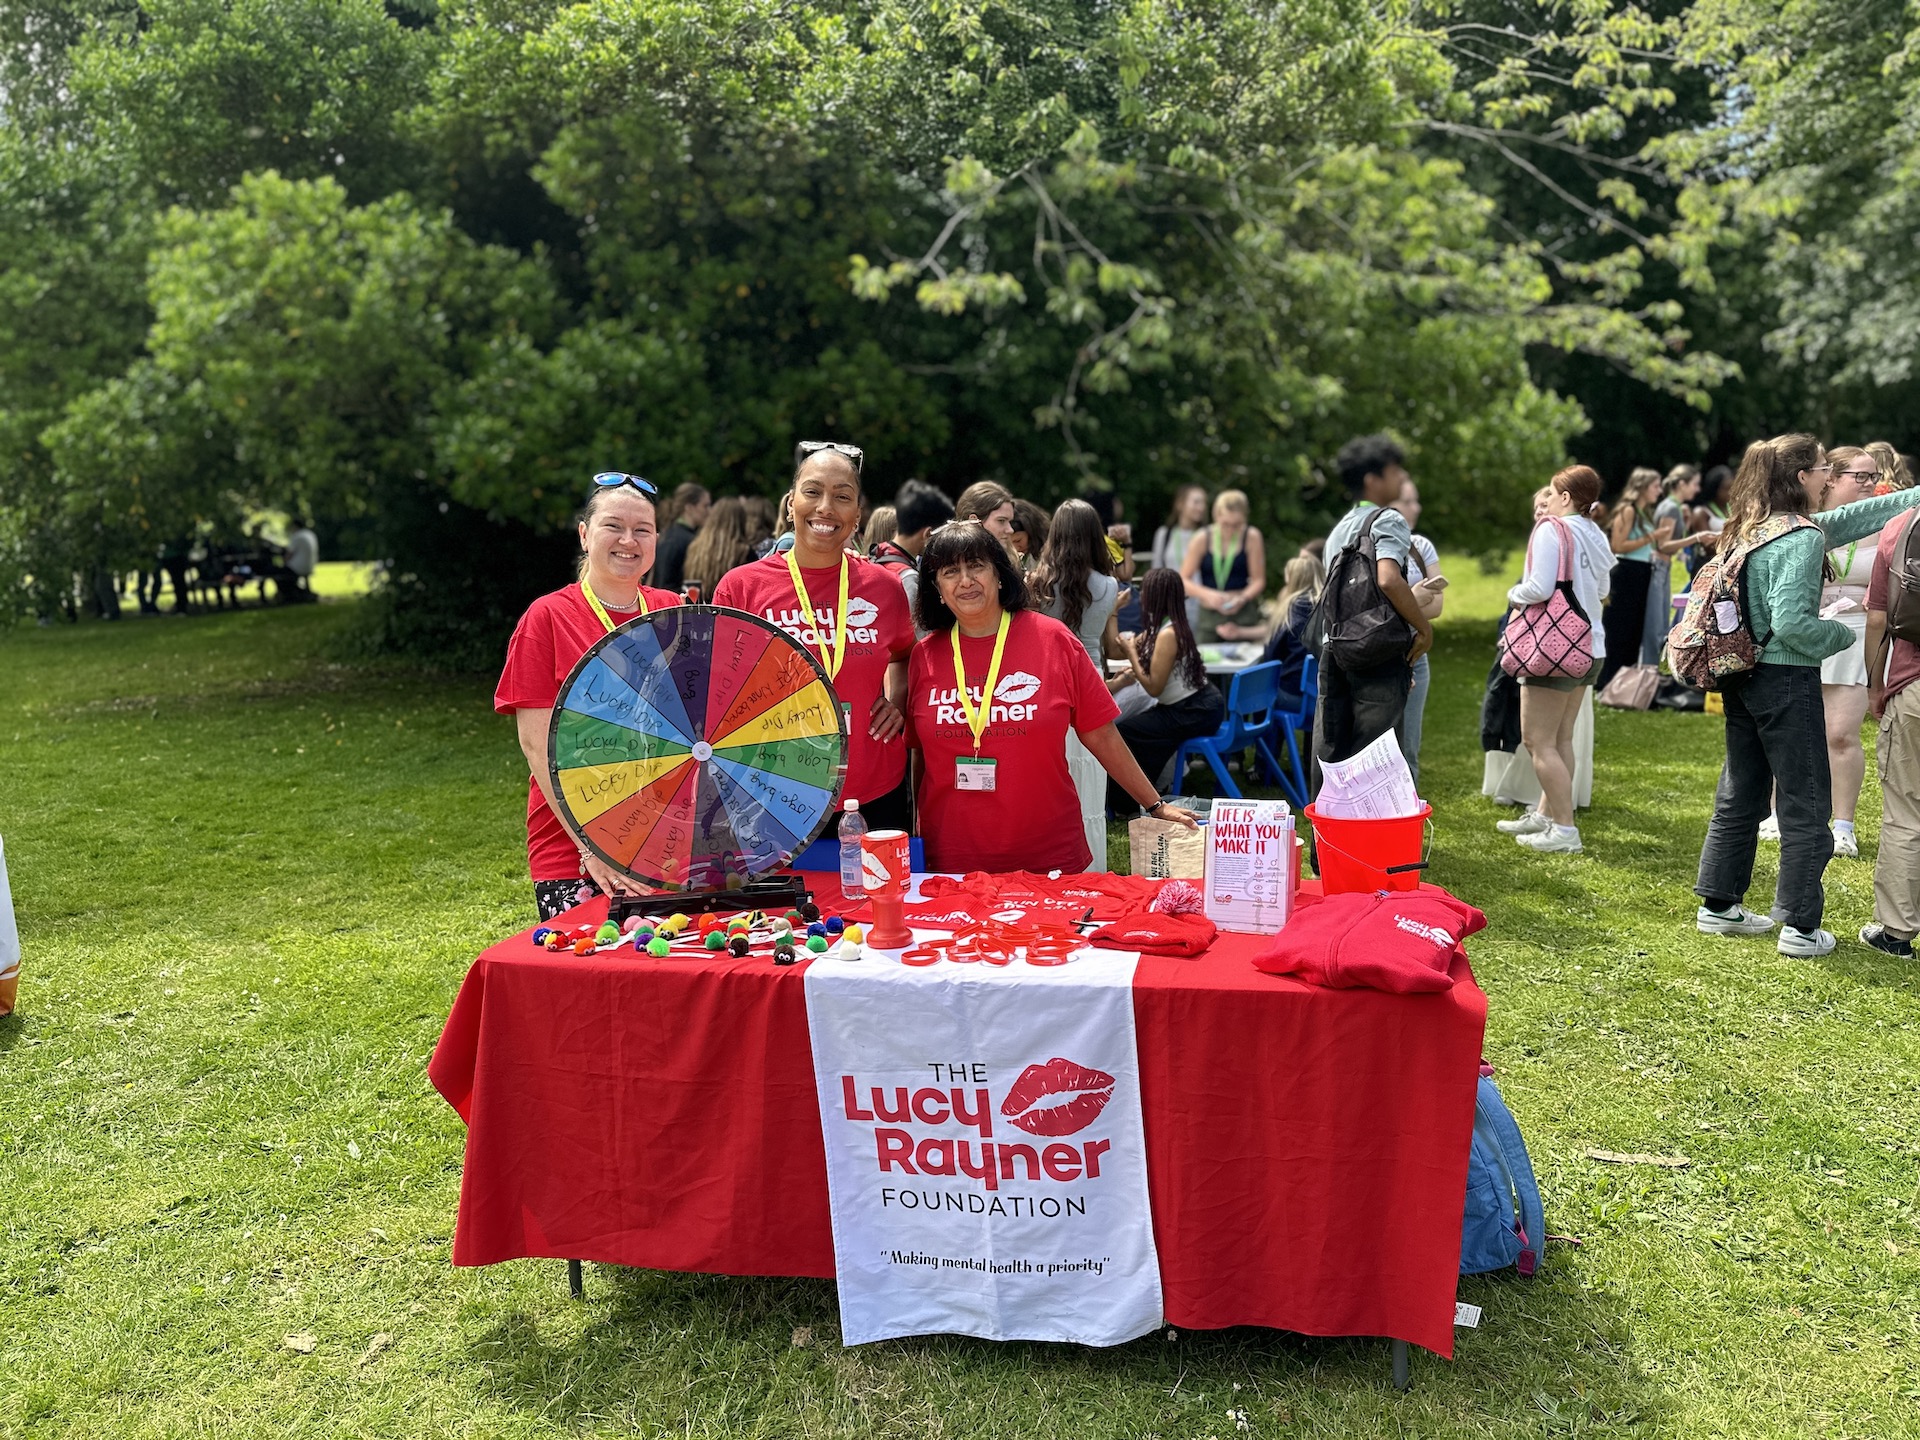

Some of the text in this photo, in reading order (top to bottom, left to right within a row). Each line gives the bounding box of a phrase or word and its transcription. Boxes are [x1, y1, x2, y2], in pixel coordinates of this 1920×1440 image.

[583, 673, 634, 719] Lucky
[787, 703, 825, 727] Lucky
[936, 703, 1038, 727] Raner
[574, 732, 619, 756] Lucky
[935, 726, 1027, 739] FOUNATION
[579, 772, 627, 803] Lucky
[599, 807, 650, 846] Lucky
[1216, 808, 1256, 823] LIFE IS
[1215, 823, 1281, 839] WHAT YOU
[643, 824, 686, 873] Lucky
[1150, 851, 1158, 866] ARE
[1215, 838, 1267, 855] MAKE IT
[1393, 914, 1430, 932] Lucy
[1396, 921, 1449, 949] Rayner
[928, 1063, 988, 1083] THE
[841, 1075, 993, 1138] Lucy
[874, 1127, 1111, 1191] Rayner
[882, 1188, 1086, 1218] FOUNDATION
[880, 1250, 1111, 1277] "Making mental health a priority"
